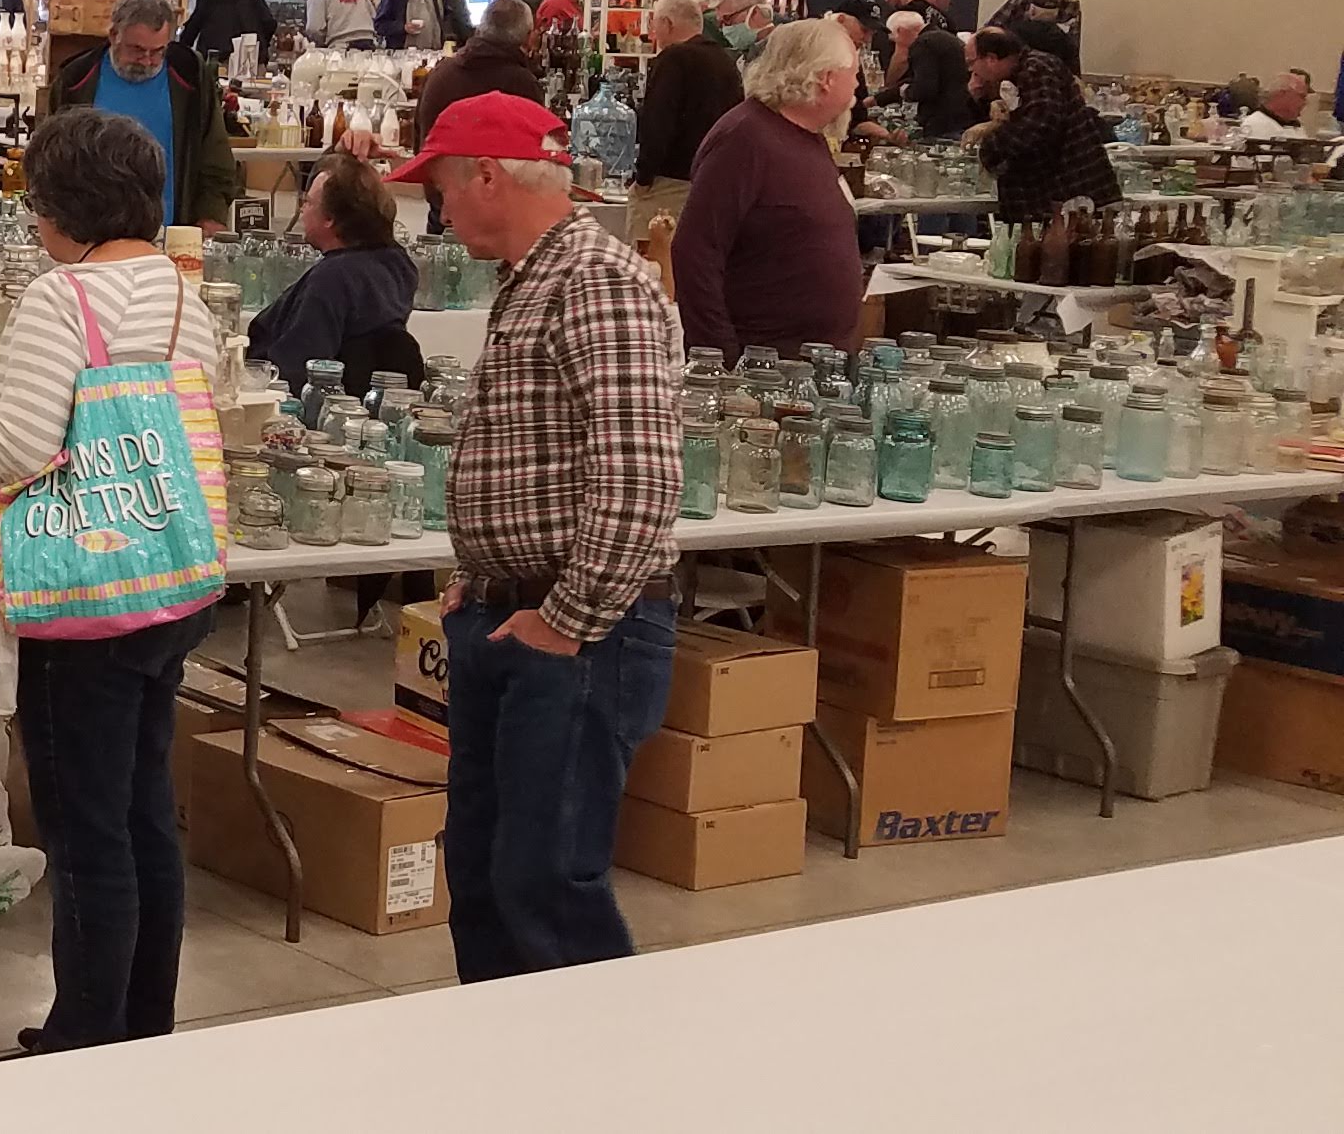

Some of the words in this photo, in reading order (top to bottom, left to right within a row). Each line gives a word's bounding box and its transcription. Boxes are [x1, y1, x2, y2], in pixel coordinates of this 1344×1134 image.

[26, 438, 115, 504] DRAMS
[117, 429, 163, 473] DO
[91, 472, 181, 531] TRUE
[873, 810, 1001, 840] Baxter
